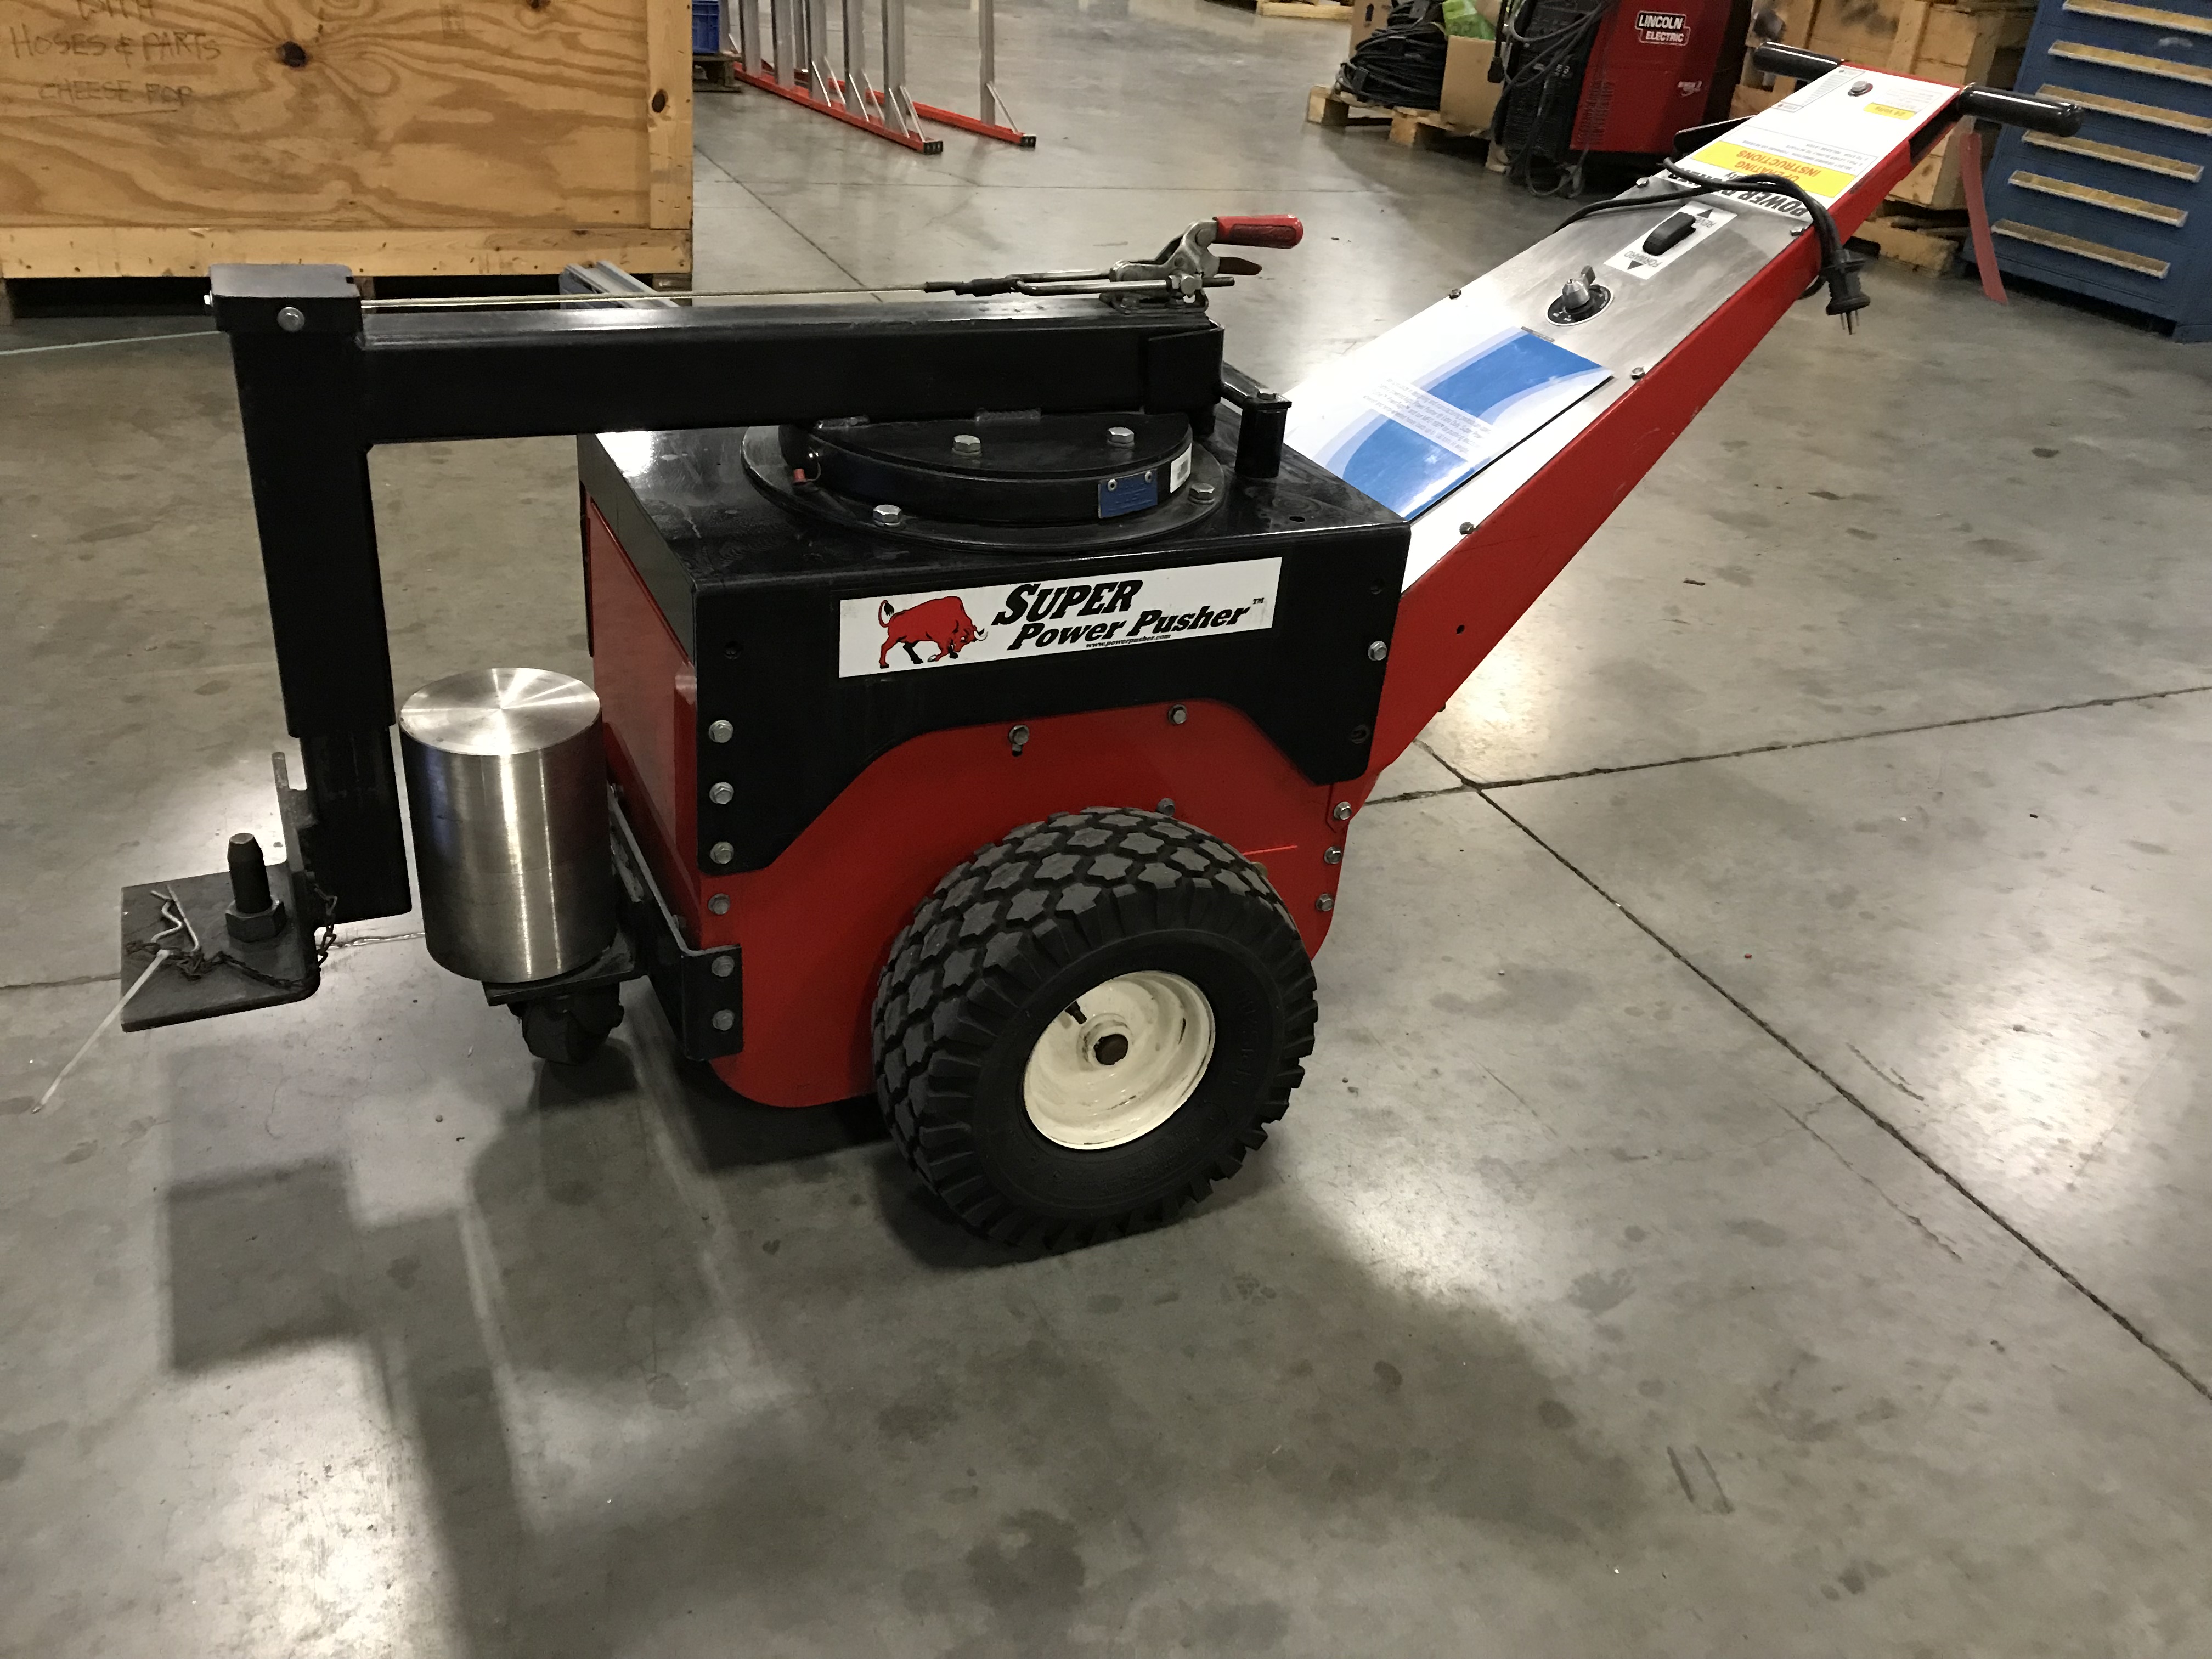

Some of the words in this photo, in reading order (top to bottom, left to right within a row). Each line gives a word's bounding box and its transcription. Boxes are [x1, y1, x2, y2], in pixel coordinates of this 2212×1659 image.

[1639, 14, 1683, 29] LINCOLN
[9, 24, 106, 58] HOSES
[142, 31, 221, 61] PARTS
[1646, 31, 1684, 42] ELECTRIC
[1736, 150, 1821, 177] INSTRUCTIONS
[1737, 190, 1809, 217] POWER
[1624, 251, 1663, 267] FORWARD
[991, 579, 1143, 625] SUPER
[1007, 620, 1127, 651] Power
[1126, 605, 1251, 636] Pusher
[1086, 634, 1171, 648] www.powerpusher.com
